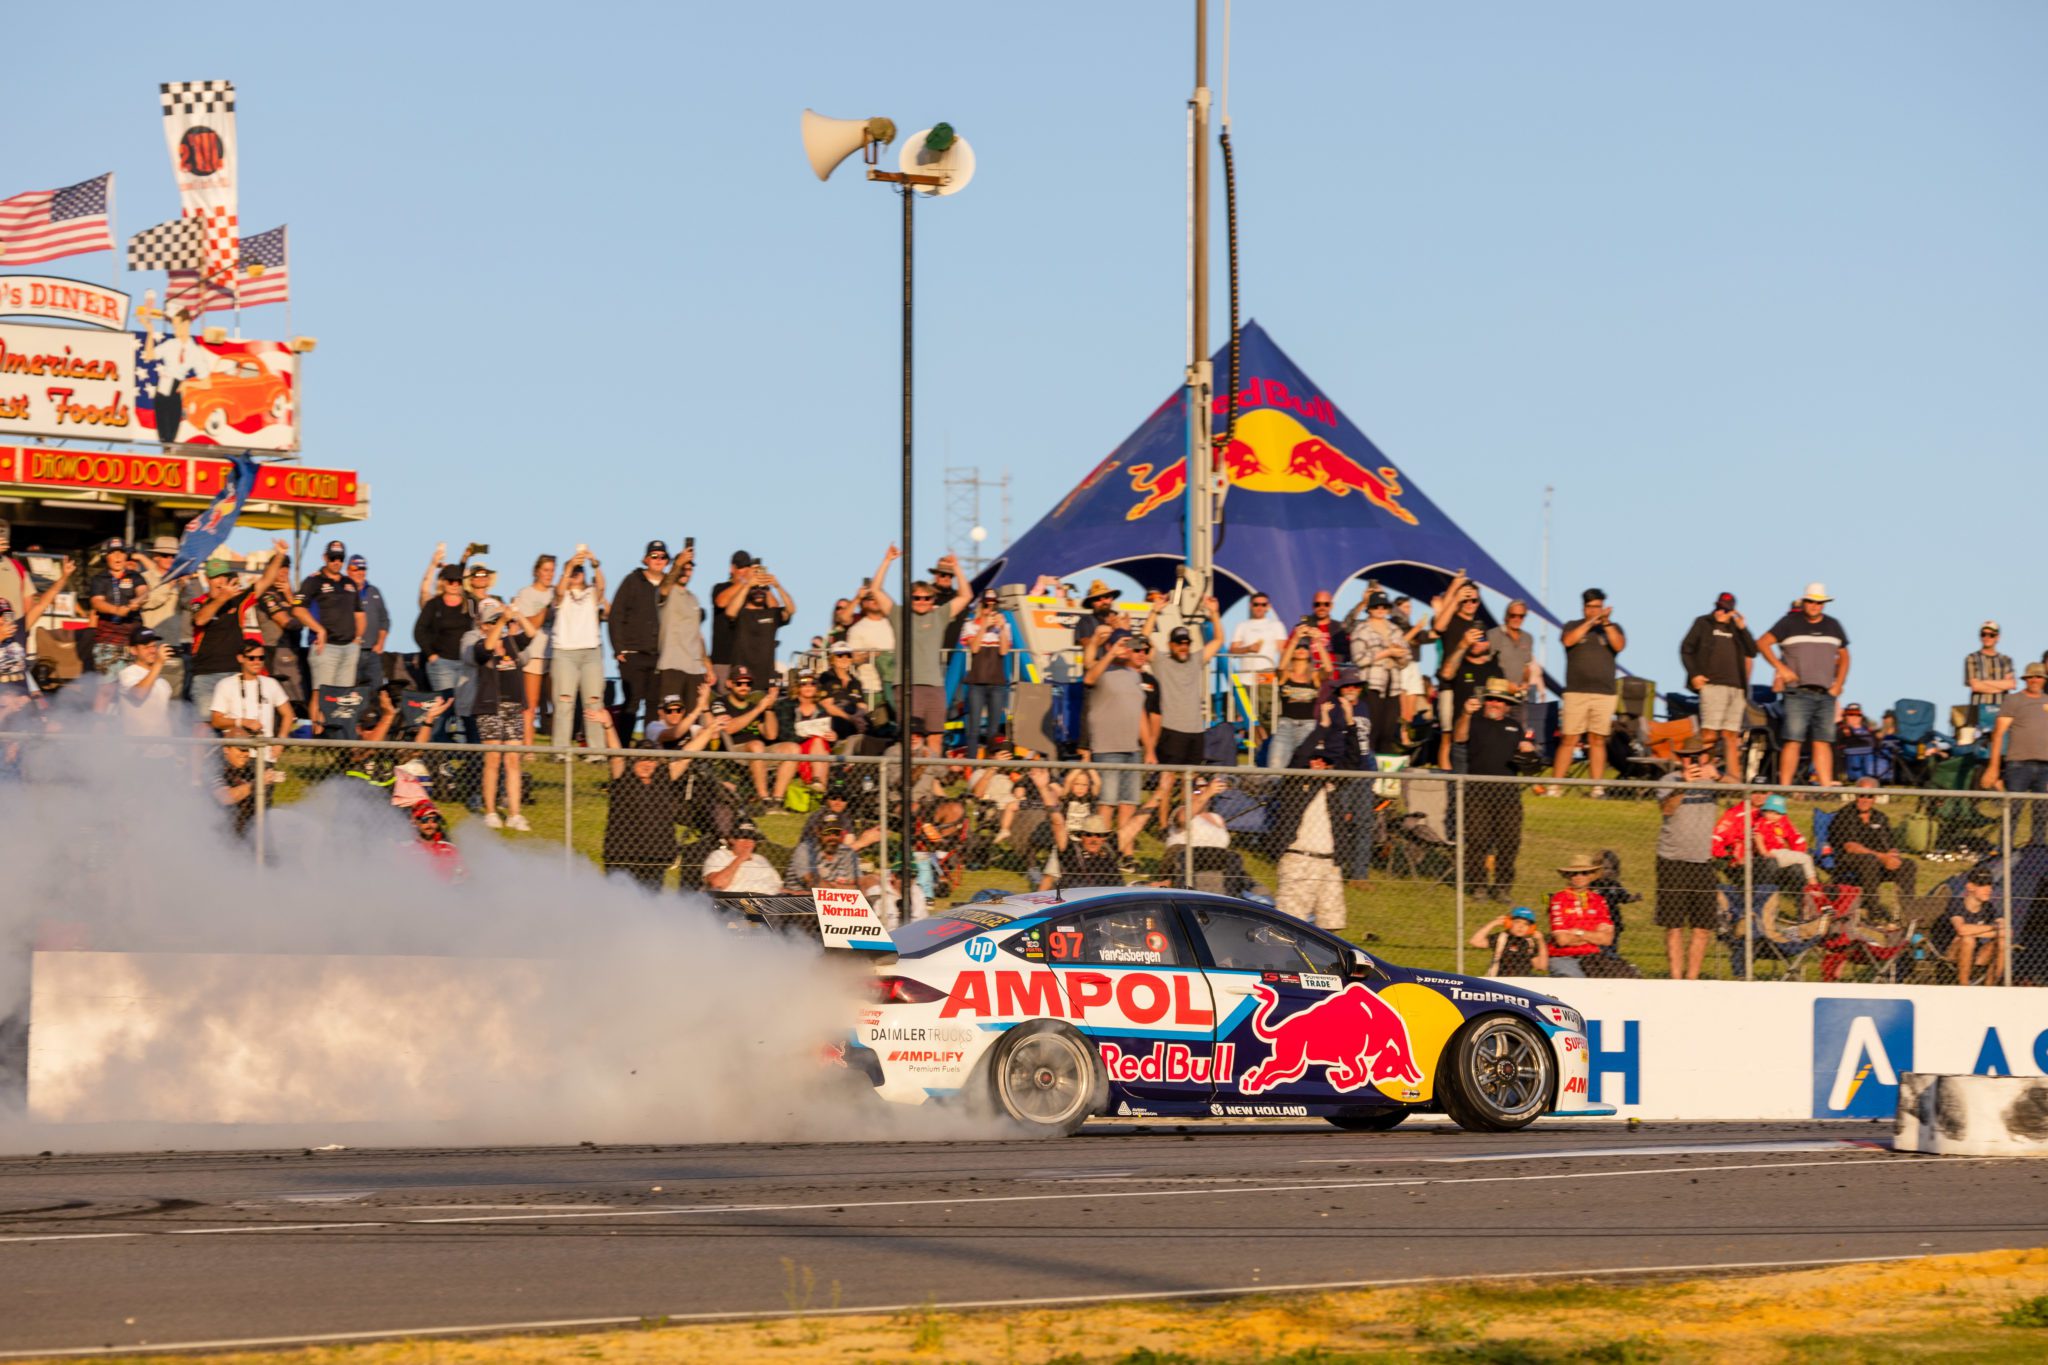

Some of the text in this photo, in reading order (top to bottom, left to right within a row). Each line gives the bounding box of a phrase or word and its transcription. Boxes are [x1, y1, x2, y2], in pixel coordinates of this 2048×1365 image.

[0, 283, 120, 321] 's DINER
[46, 386, 129, 427] Foods
[1264, 379, 1338, 427] Bull
[131, 460, 182, 487] DOGS
[817, 890, 859, 905] Harvey
[822, 905, 868, 917] Norman
[824, 925, 881, 936] ToolPRO
[970, 938, 993, 962] hp
[1049, 931, 1084, 959] 97
[1424, 977, 1464, 986] DUNLOP
[939, 970, 1213, 1026] AMPOL
[1450, 987, 1529, 1008] ToolPRO
[871, 1028, 973, 1042] DAIMLER TRUCKS
[898, 1051, 964, 1062] AMPLIFY
[1099, 1042, 1235, 1083] Red Bull
[909, 1064, 961, 1073] Premium Fuels
[1226, 1105, 1307, 1116] NEW HOLLAND
